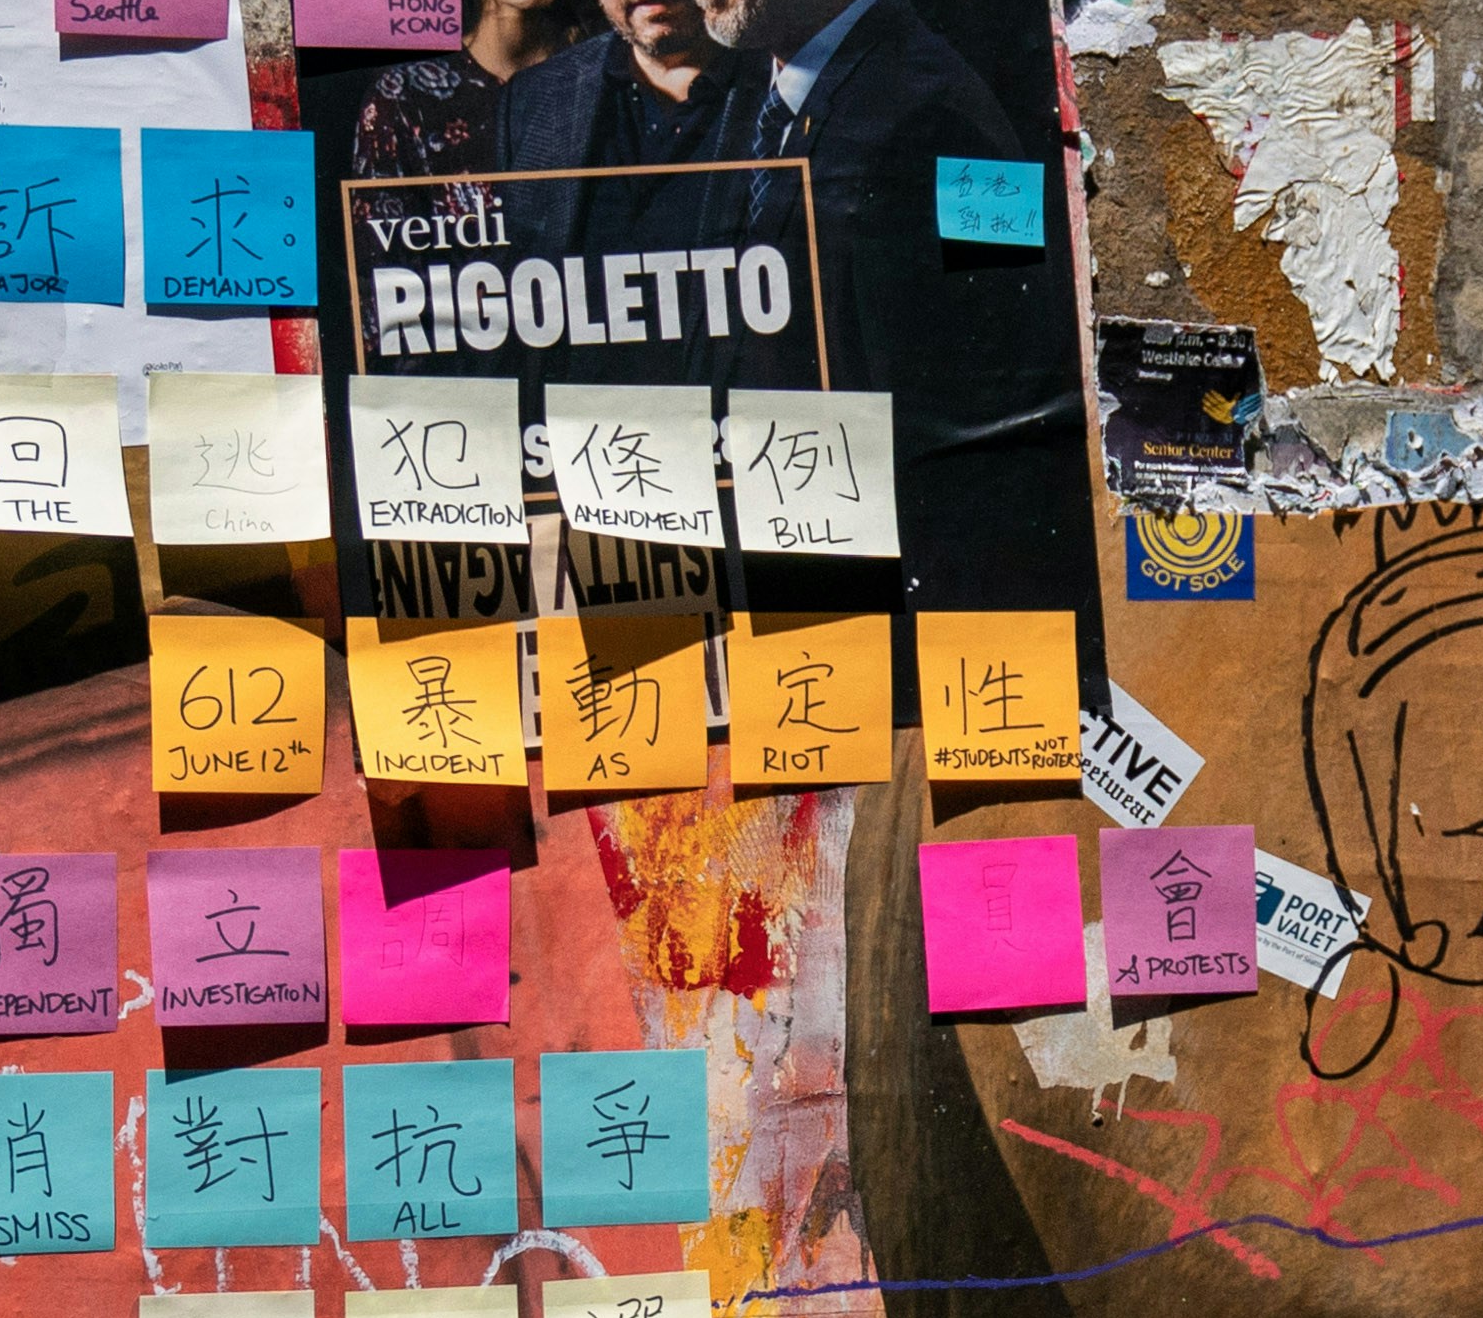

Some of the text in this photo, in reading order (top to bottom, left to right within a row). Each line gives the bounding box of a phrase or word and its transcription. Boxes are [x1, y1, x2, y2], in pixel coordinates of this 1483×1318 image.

[390, 17, 460, 38] KONG
[367, 196, 511, 252] verdi
[163, 276, 296, 300] DEMANDS
[373, 244, 792, 357] RIGOLETTO
[381, 417, 481, 491] 犯
[572, 423, 673, 500] 條
[748, 420, 860, 505] 例
[1143, 442, 1234, 460] Senior Center
[3, 499, 79, 525] THE
[370, 501, 524, 529] EXTRADICTION
[574, 504, 714, 538] AMENDMENT
[771, 517, 852, 548] BILL
[1140, 552, 1245, 592] GOT SOLE
[179, 666, 298, 733] 612
[400, 654, 484, 749] 暴
[567, 653, 663, 748] 動
[776, 653, 862, 733] 定
[944, 657, 1046, 736] 性
[169, 739, 312, 783] JUNE 12th
[374, 749, 505, 778] INCIDENT
[762, 745, 830, 773] RIOT
[934, 747, 1085, 770] #STUDENTS RIOTERS
[1035, 737, 1068, 752] NOT
[587, 752, 632, 781] AS
[1149, 848, 1213, 943] 會
[1282, 894, 1350, 935] PORT
[194, 888, 290, 966] 立
[1277, 915, 1338, 954] VALET
[1147, 953, 1251, 978] PROTESTS
[161, 979, 322, 1011] INVESTIGATION
[171, 1095, 289, 1202] 對
[371, 1102, 481, 1197] 抗
[584, 1078, 671, 1191] 爭
[393, 1201, 460, 1231] ALL
